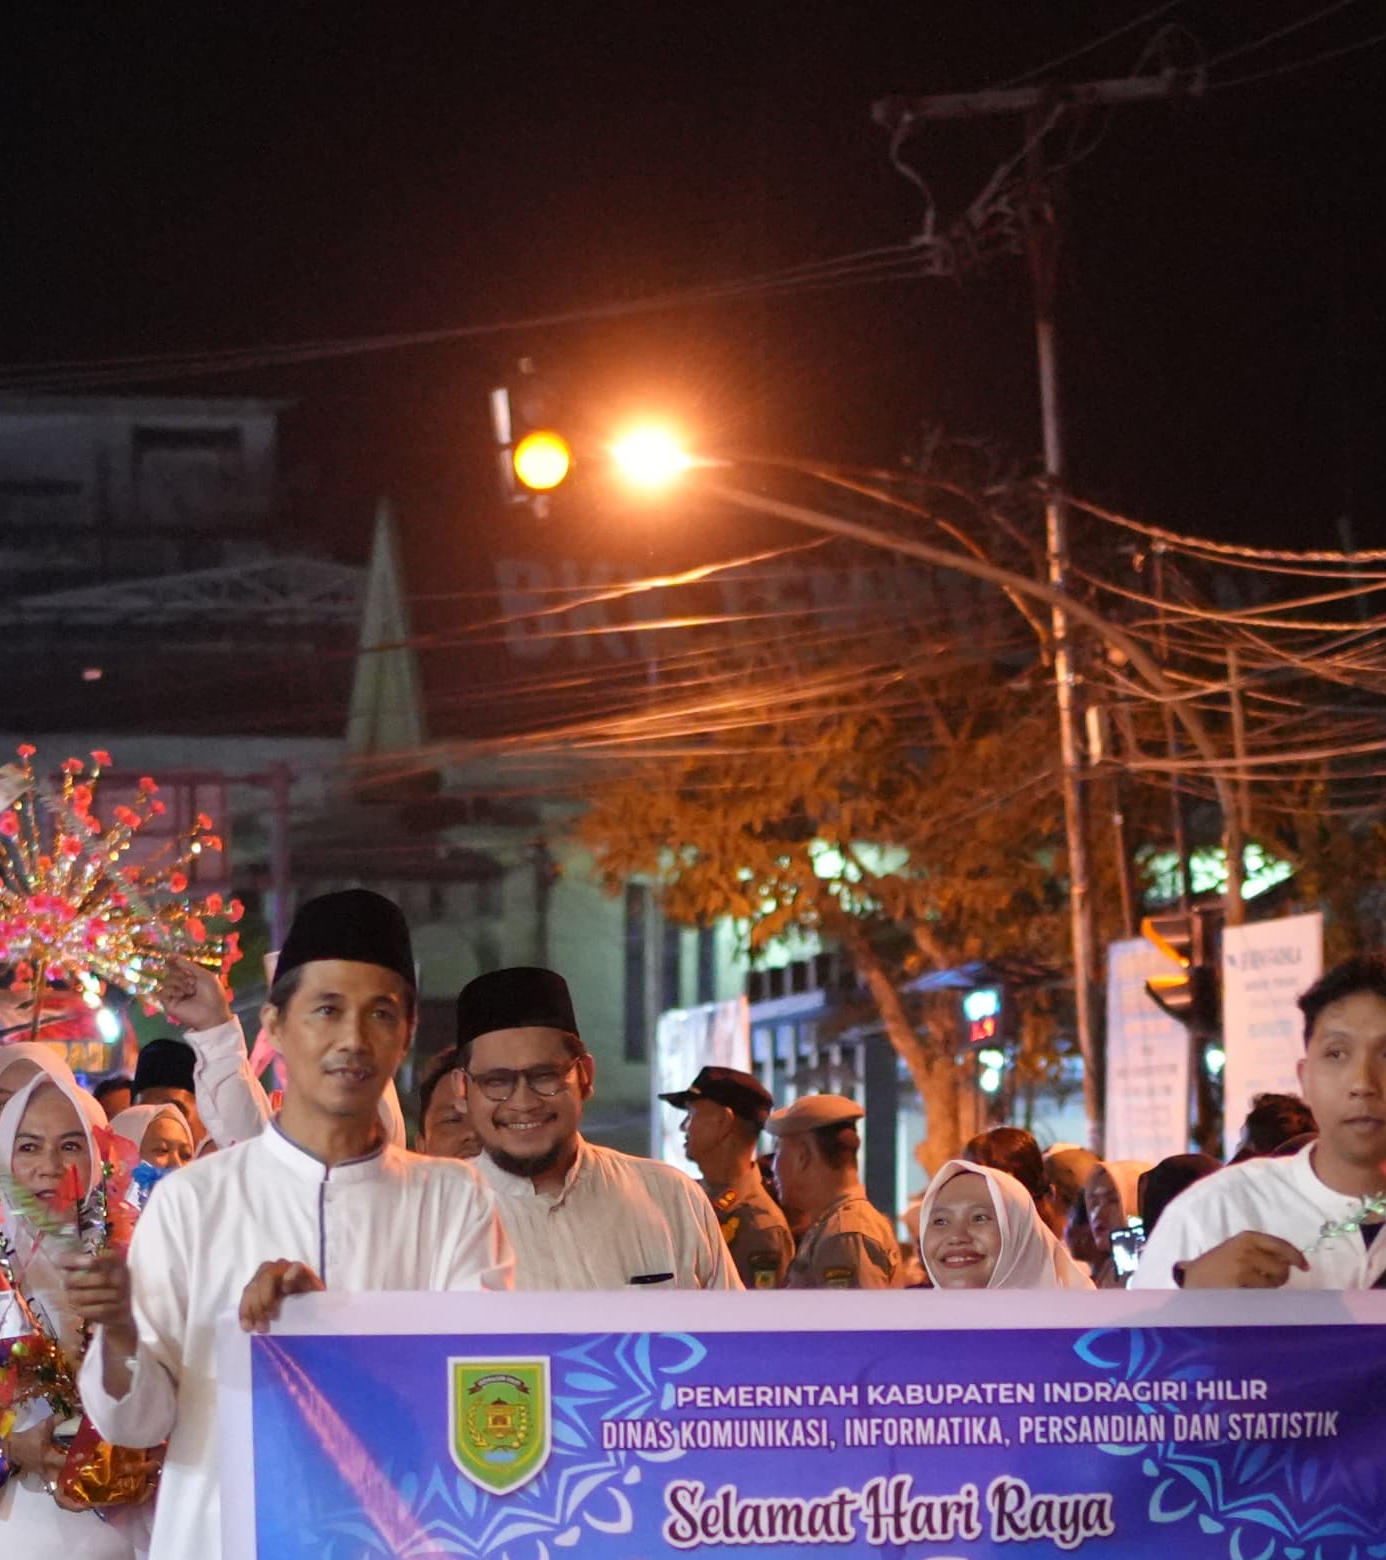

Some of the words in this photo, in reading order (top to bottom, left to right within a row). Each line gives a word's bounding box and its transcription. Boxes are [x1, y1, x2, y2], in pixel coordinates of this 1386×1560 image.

[676, 1384, 858, 1409] PEMERINTAH
[867, 1382, 1035, 1407] KABUPATEN
[1044, 1381, 1187, 1403] INDRAGIRI
[1196, 1379, 1268, 1401] HILIR
[602, 1419, 674, 1450] DINAS
[679, 1417, 836, 1450] KOMUNIKASI,
[844, 1415, 1010, 1448] INFORMATIKA,
[1019, 1413, 1165, 1444] PERSANDIAN
[1173, 1412, 1220, 1442] DAN
[1228, 1410, 1340, 1440] STATISTIK
[667, 1482, 857, 1545] Selamat
[862, 1477, 978, 1543] Hari
[989, 1477, 1112, 1548] Raya
